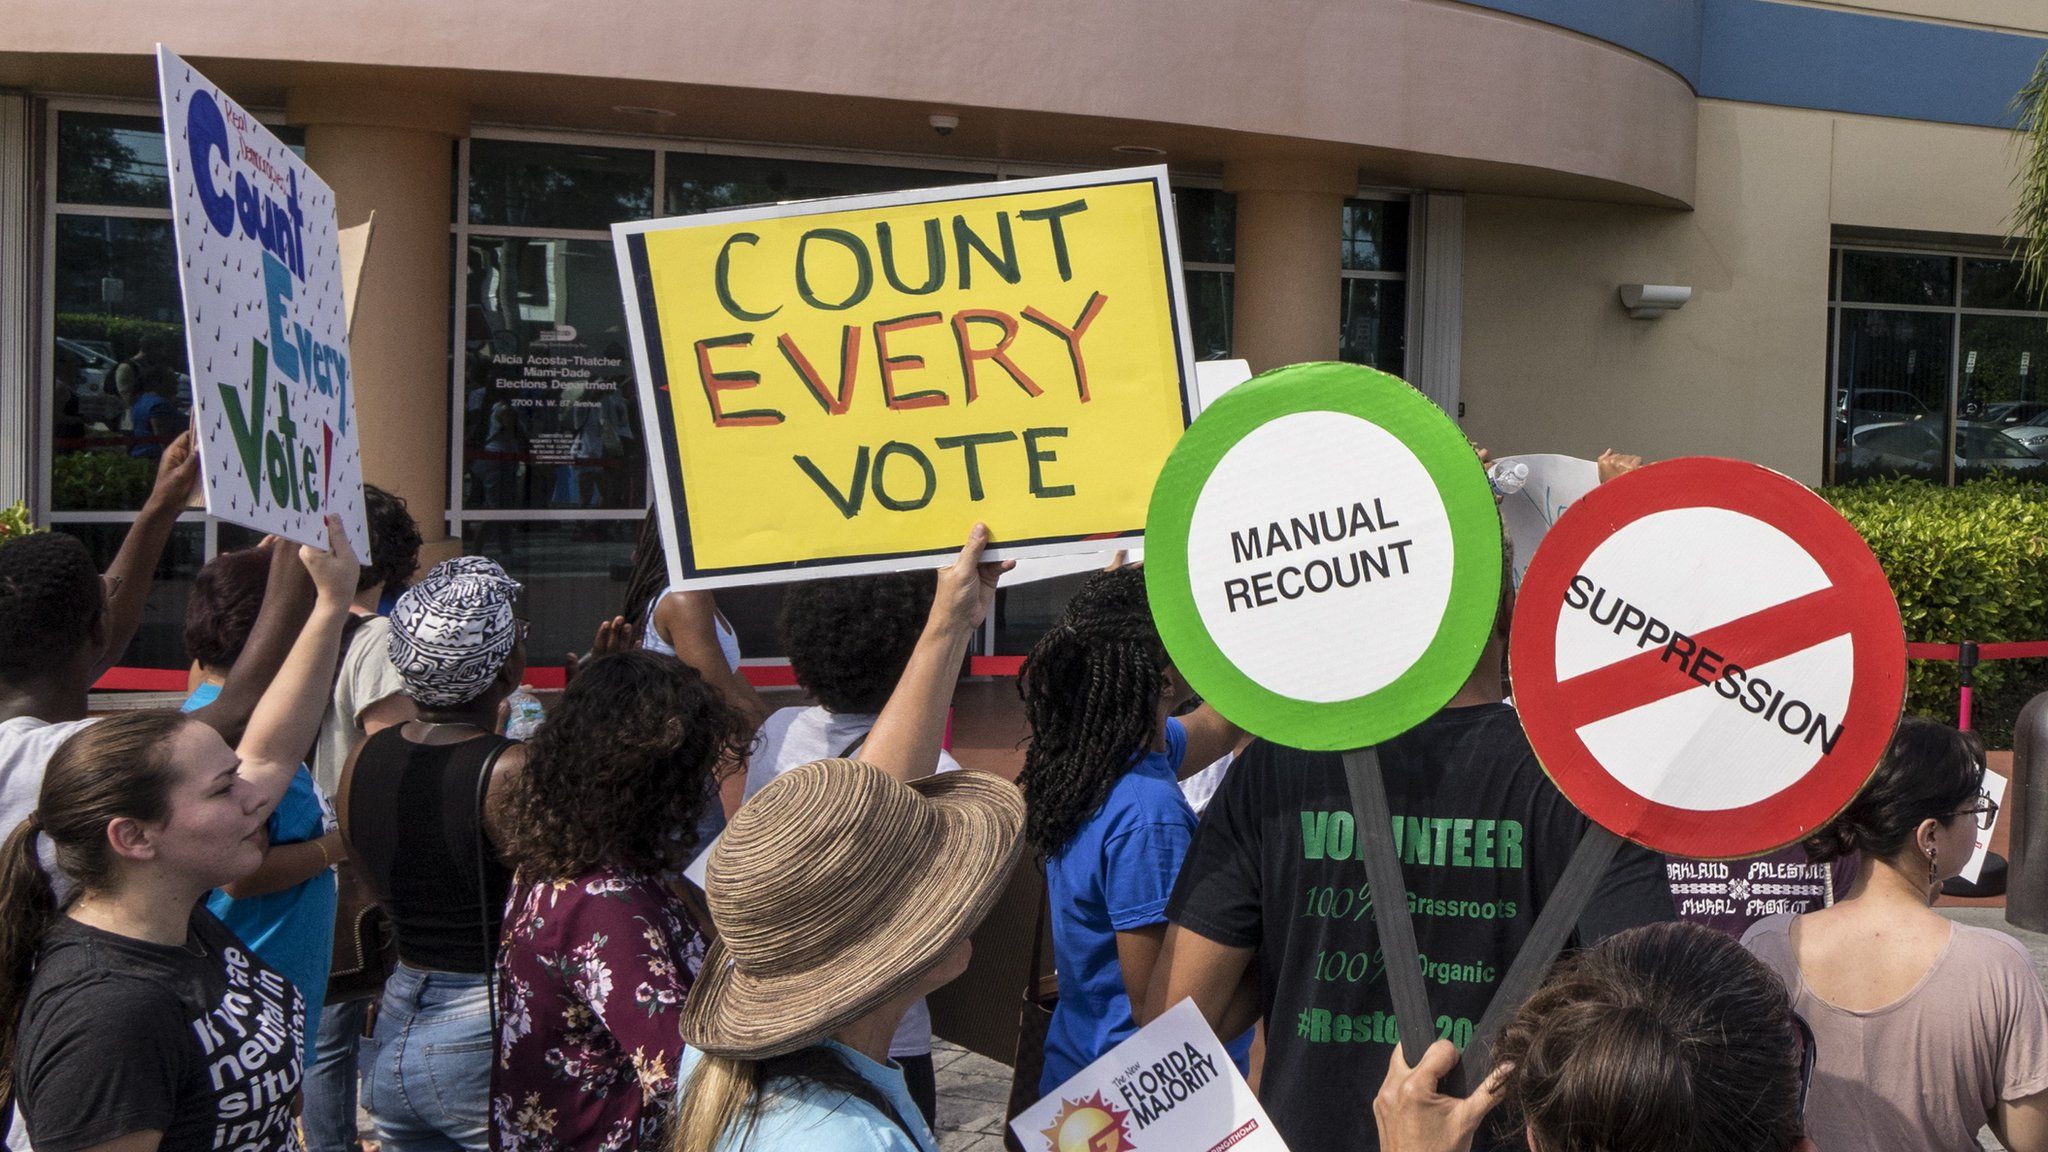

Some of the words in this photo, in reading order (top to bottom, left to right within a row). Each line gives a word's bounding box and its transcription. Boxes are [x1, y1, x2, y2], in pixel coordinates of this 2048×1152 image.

[187, 89, 305, 284] Count
[715, 199, 1088, 322] COUNT
[262, 250, 347, 438] Every
[493, 354, 523, 365] Alicia
[527, 355, 622, 367] Acosta-Thatcher
[524, 367, 591, 378] Miami-Dade
[695, 291, 1108, 428] EVERY
[496, 379, 548, 390] Elections
[551, 379, 617, 391] Department
[511, 399, 533, 408] 2700
[573, 400, 602, 409] Avenue
[793, 428, 1076, 520] VOTE
[1230, 498, 1401, 564] MANUAL
[1224, 540, 1414, 613] RECOUNT
[1563, 574, 1846, 757] SUPPRESSION
[1681, 898, 1736, 916] MURAL
[1746, 897, 1810, 916] PROJECT
[209, 988, 287, 1091] neutral
[253, 968, 284, 998] in
[1297, 1007, 1401, 1046] #Resto
[1112, 1075, 1127, 1088] The
[1125, 1062, 1141, 1078] New
[1120, 1042, 1203, 1109] FLORIDA
[1132, 1053, 1219, 1130] MAJORITY
